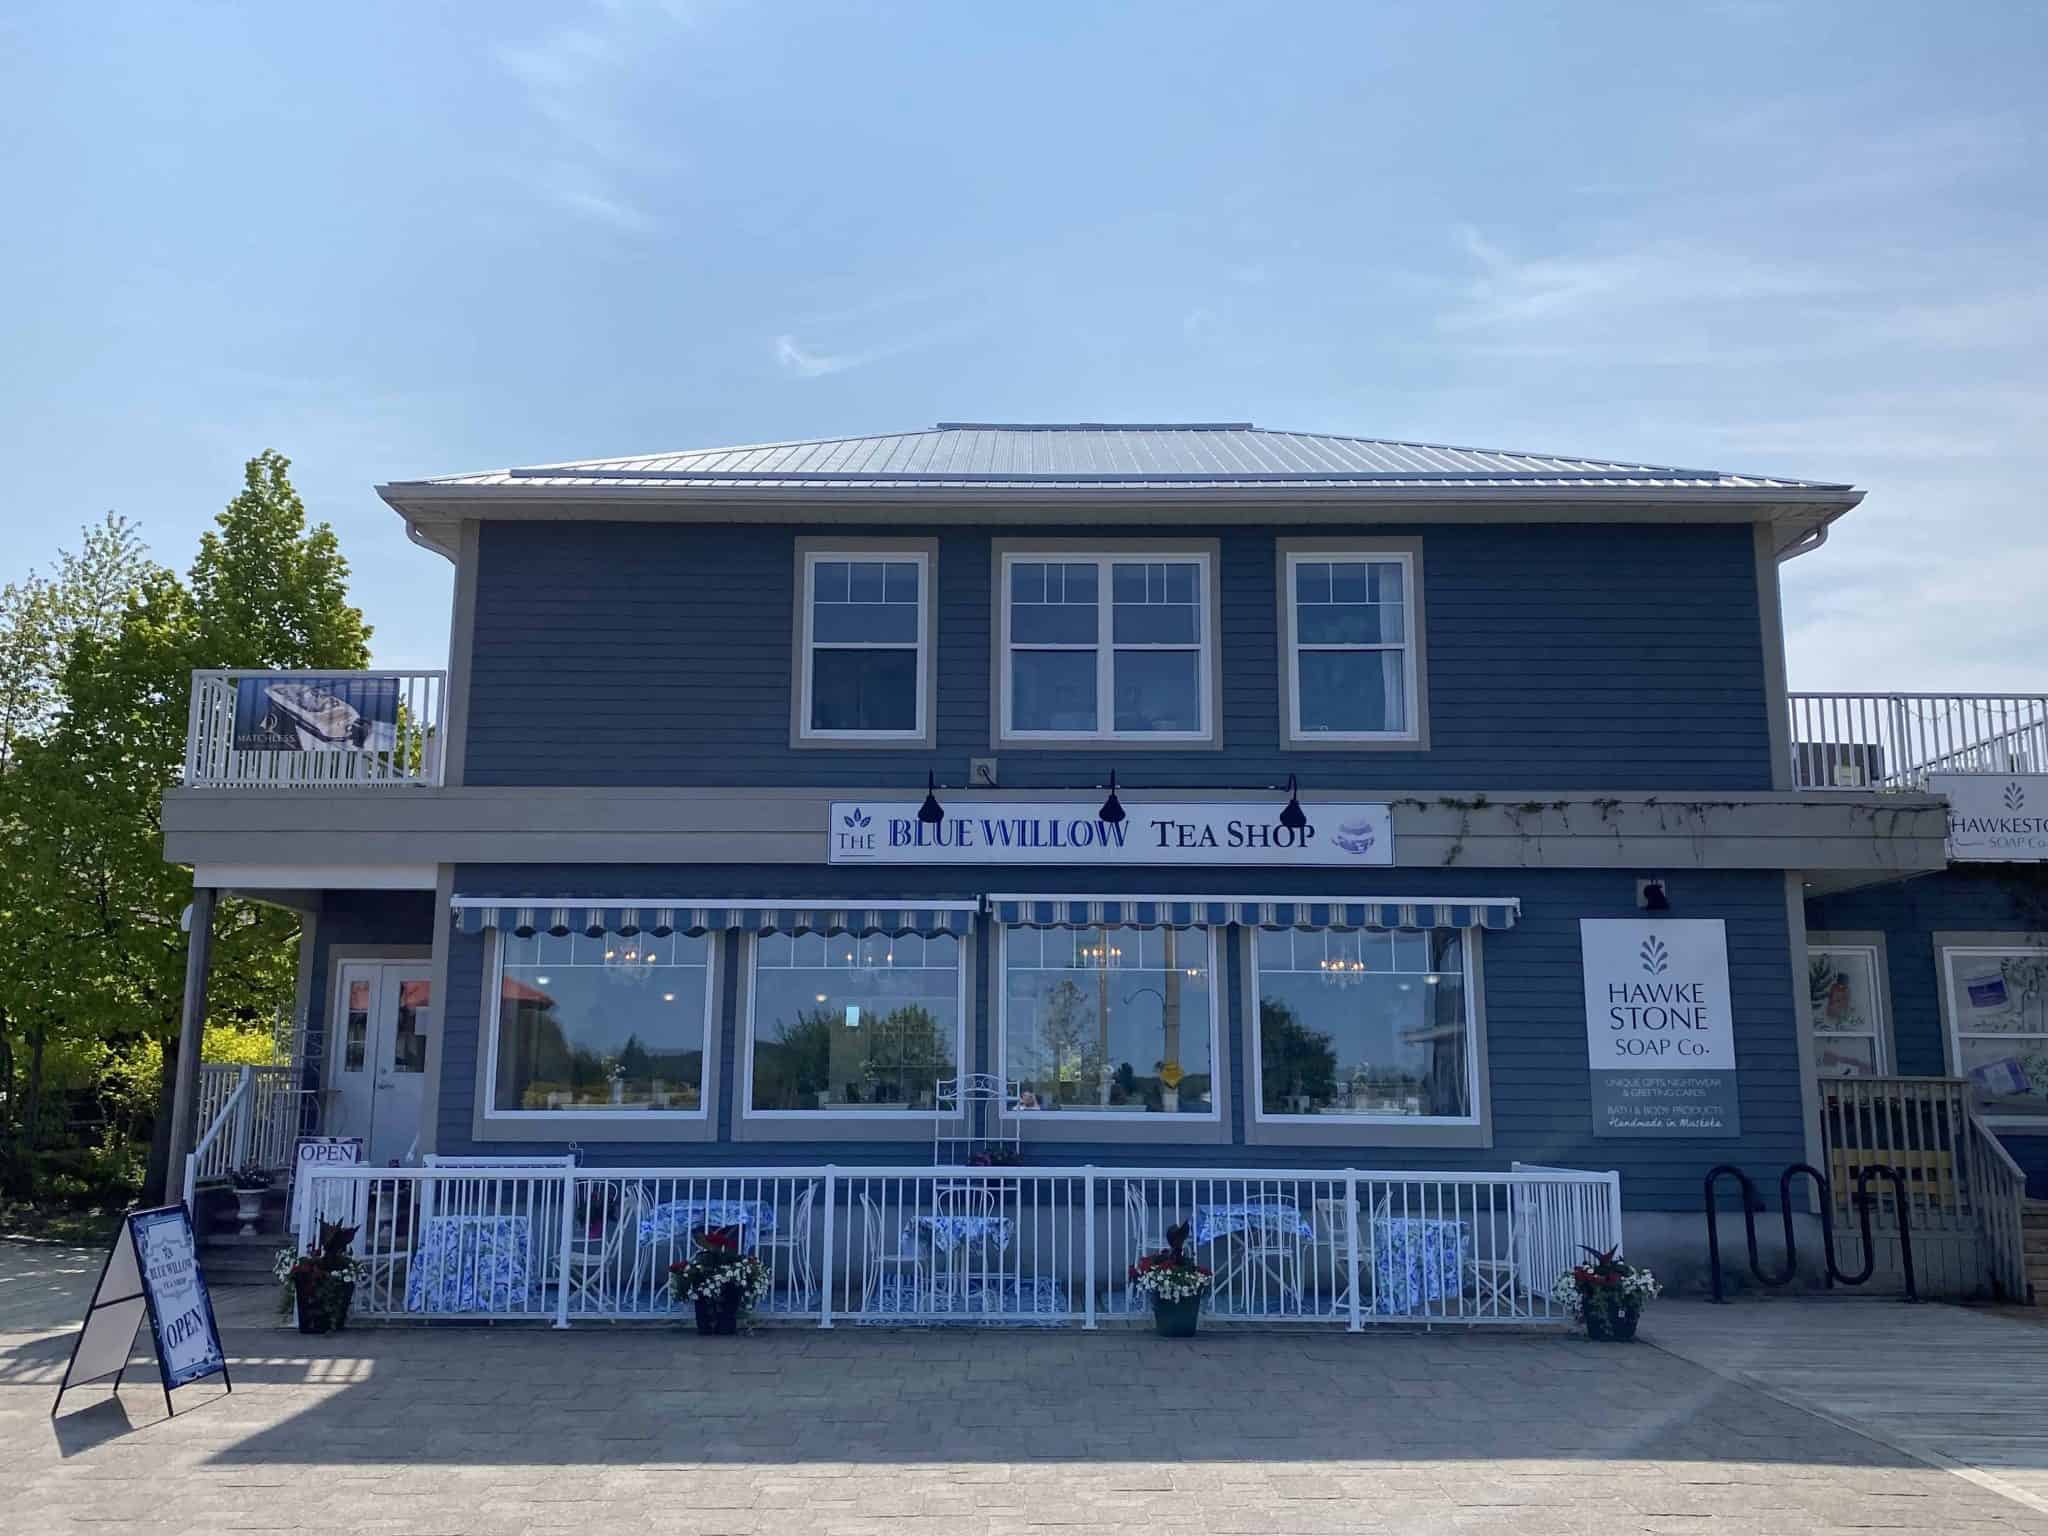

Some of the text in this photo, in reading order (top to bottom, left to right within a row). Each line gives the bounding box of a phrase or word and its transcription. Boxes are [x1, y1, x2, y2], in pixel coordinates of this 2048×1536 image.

[836, 818, 1315, 850] THE BLUE WILLOW TEA SHOP
[1609, 983, 1704, 1004] HAWKE
[1610, 1006, 1709, 1031] STONE
[1615, 1038, 1710, 1056] SOAP Co.
[1608, 1117, 1662, 1128] Handmade
[1665, 1118, 1676, 1128] in
[300, 1145, 353, 1161] OPEN
[166, 1305, 203, 1349] OPEN
